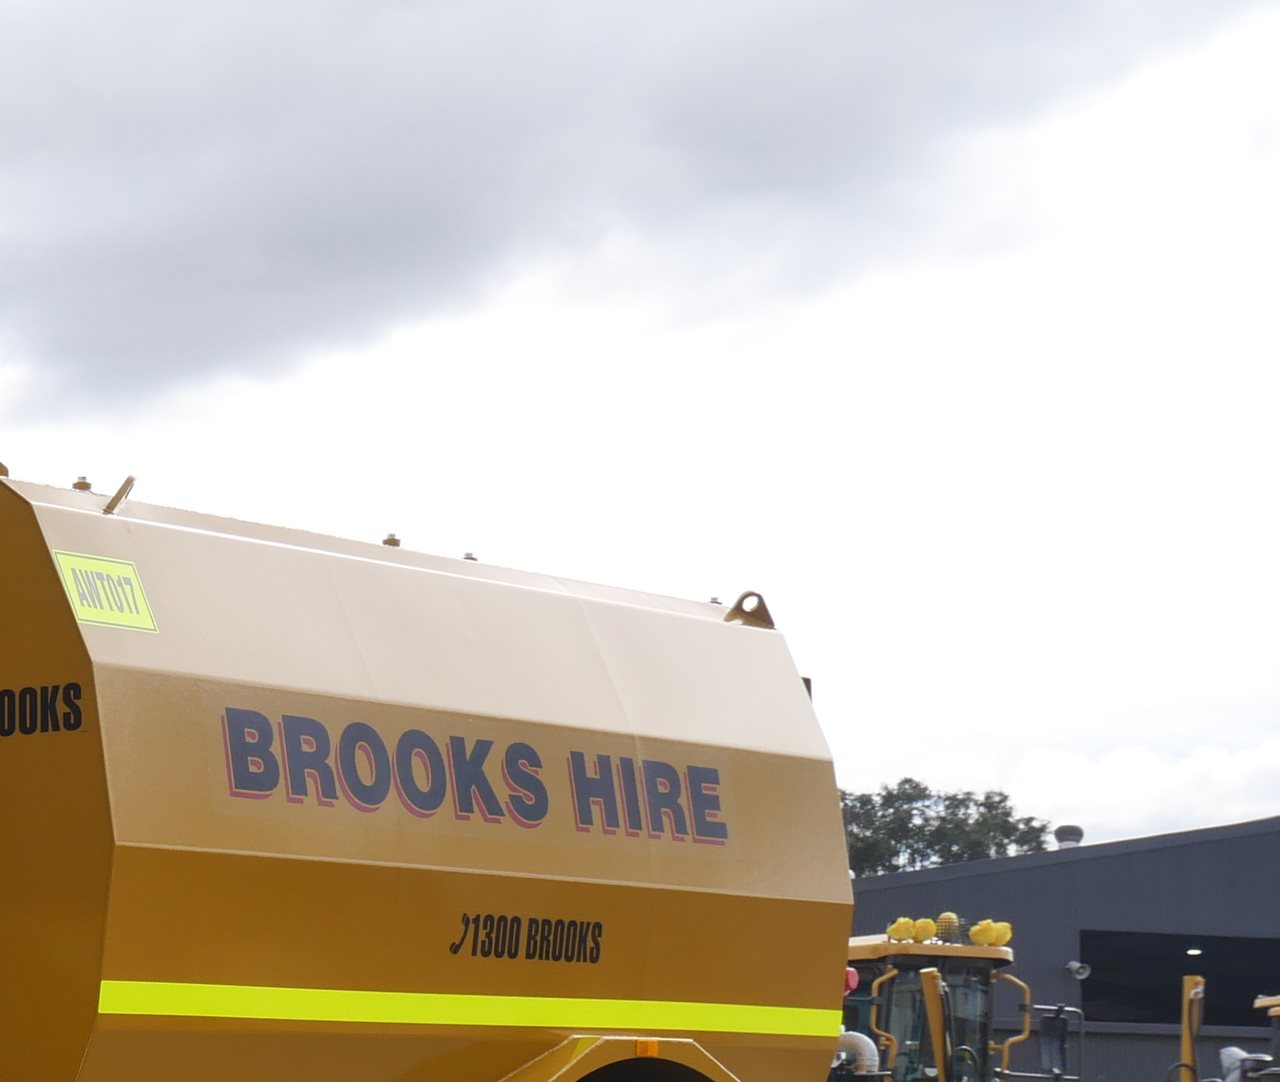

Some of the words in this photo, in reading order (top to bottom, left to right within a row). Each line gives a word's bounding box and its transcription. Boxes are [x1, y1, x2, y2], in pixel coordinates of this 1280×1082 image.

[70, 567, 140, 615] AWT017
[220, 706, 550, 829] BROOKS
[566, 749, 729, 846] HIRE
[471, 913, 522, 959] 1300
[525, 917, 603, 964] BROOKS
